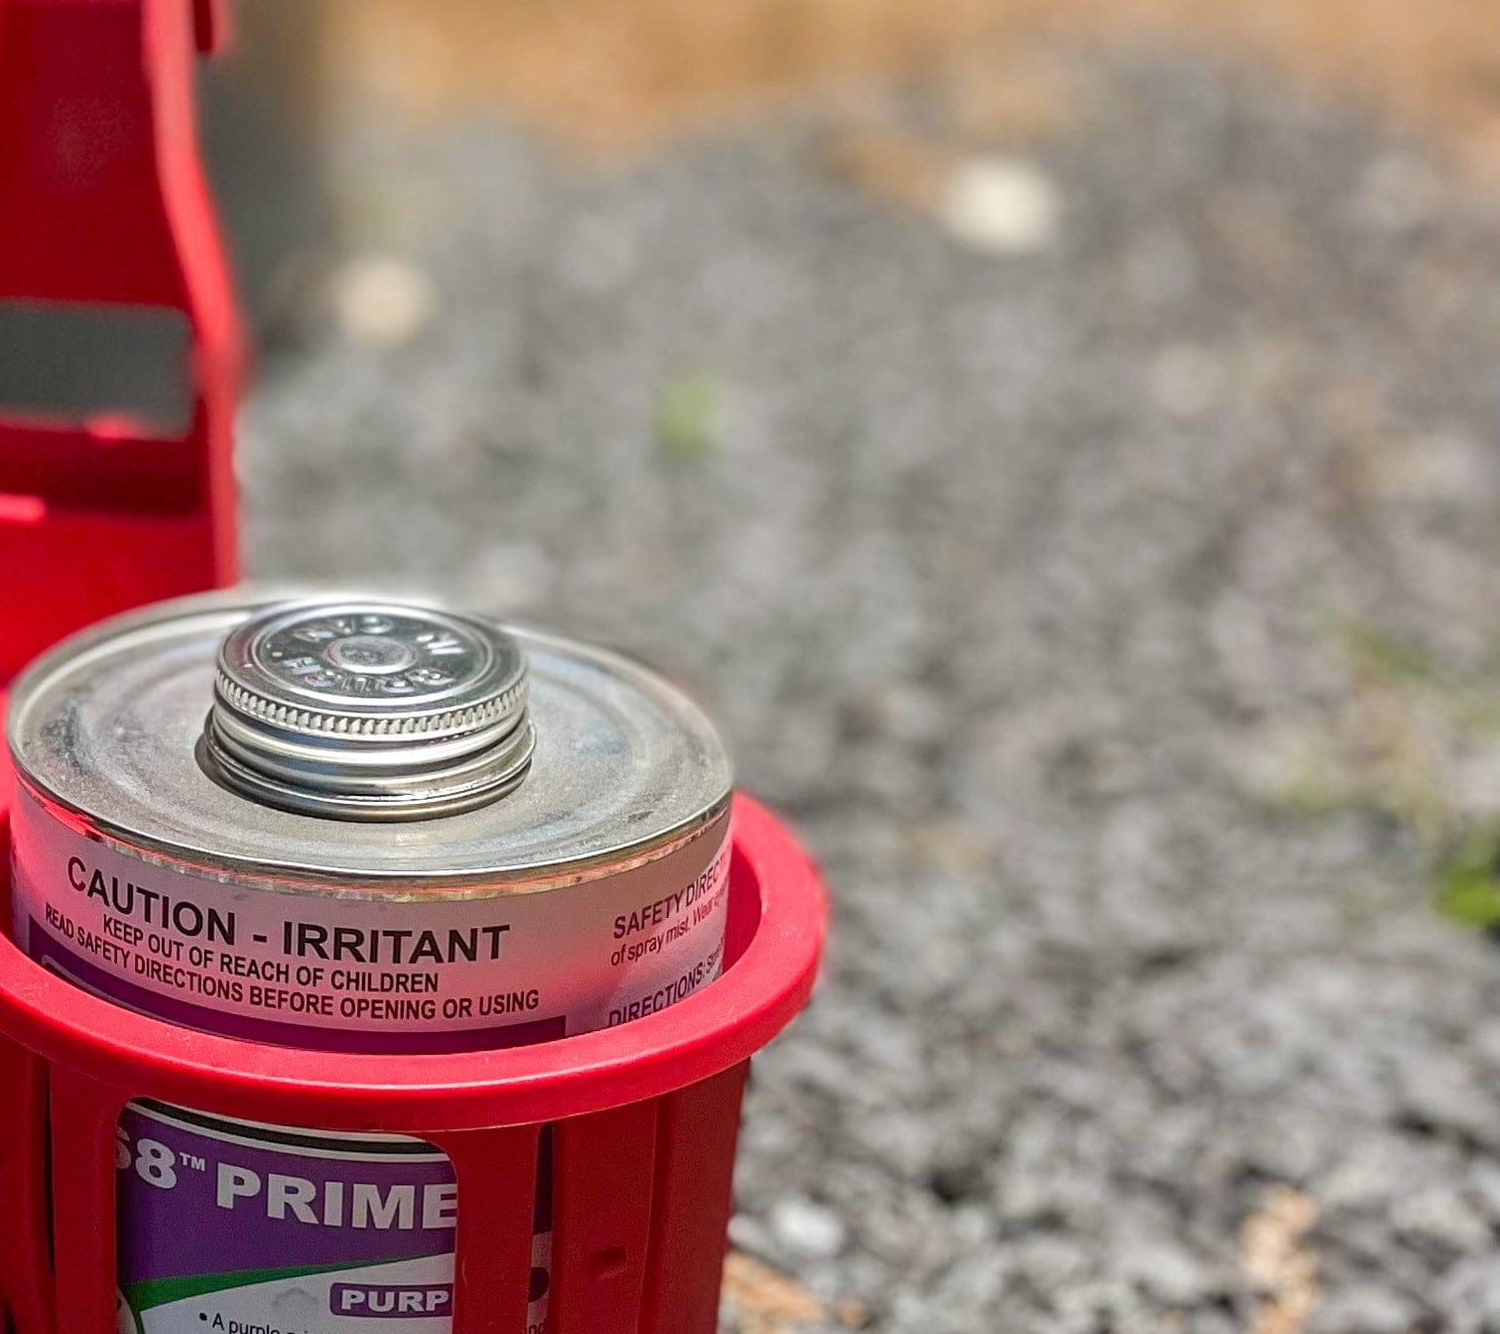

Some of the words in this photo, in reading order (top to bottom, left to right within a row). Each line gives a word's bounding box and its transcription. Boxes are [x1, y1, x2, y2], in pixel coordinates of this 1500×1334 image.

[67, 856, 235, 946] CAUTION
[282, 920, 511, 965] IRRITANT
[613, 890, 684, 940] SAFETY
[45, 902, 75, 939] READ
[76, 925, 131, 968] SAFETY
[134, 954, 243, 1003] DIRECTIONS
[249, 985, 334, 1016] BEFORE
[339, 998, 437, 1021] OPENING
[442, 997, 473, 1019] OR
[478, 989, 540, 1017] USING
[102, 913, 144, 947] KEEP
[149, 933, 184, 962] OUT
[188, 946, 214, 969] OF
[219, 953, 290, 984] REACH
[296, 965, 324, 988] OF
[330, 969, 439, 994] CHILDREN
[610, 941, 626, 966] of
[627, 935, 663, 963] spray
[211, 1312, 225, 1331] A
[340, 1288, 449, 1313] PURP
